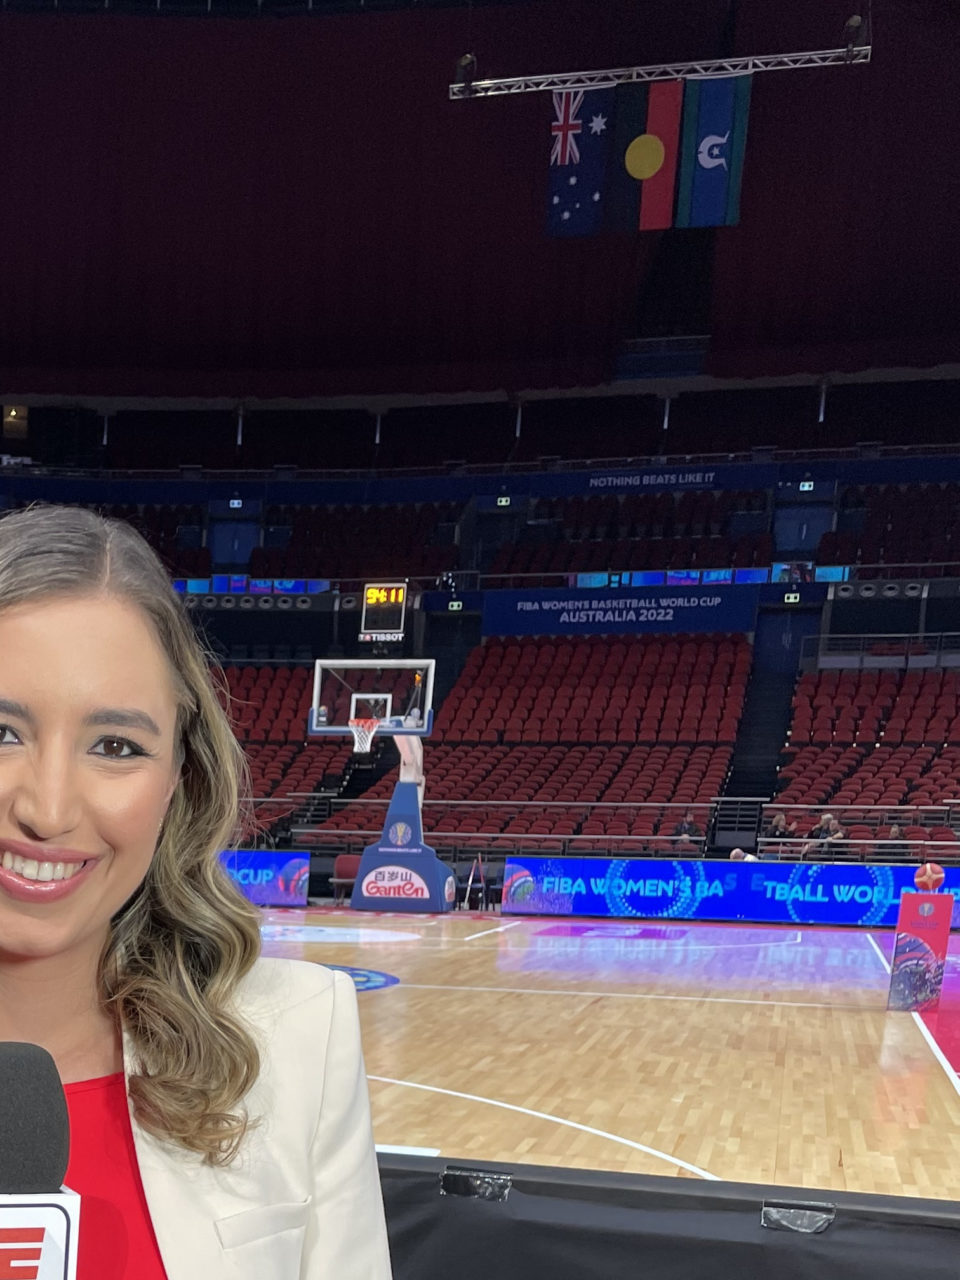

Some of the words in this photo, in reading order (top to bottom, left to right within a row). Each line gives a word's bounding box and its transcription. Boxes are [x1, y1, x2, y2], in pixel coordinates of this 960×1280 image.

[589, 476, 640, 487] NOTHING
[642, 474, 677, 485] BEATS
[678, 473, 703, 483] LIKE
[704, 472, 715, 482] IT
[517, 602, 540, 611] FIBA
[592, 599, 657, 609] BASKETBALL
[659, 597, 698, 607] WORLD
[700, 597, 722, 606] CUP
[559, 610, 636, 623] AUSTRALIA
[639, 609, 674, 621] 2022
[371, 633, 405, 641] TISSOT
[238, 868, 274, 887] CUP
[374, 870, 412, 882] 百岁山
[542, 877, 587, 895] FIBA
[590, 876, 693, 898] WOMEN'S
